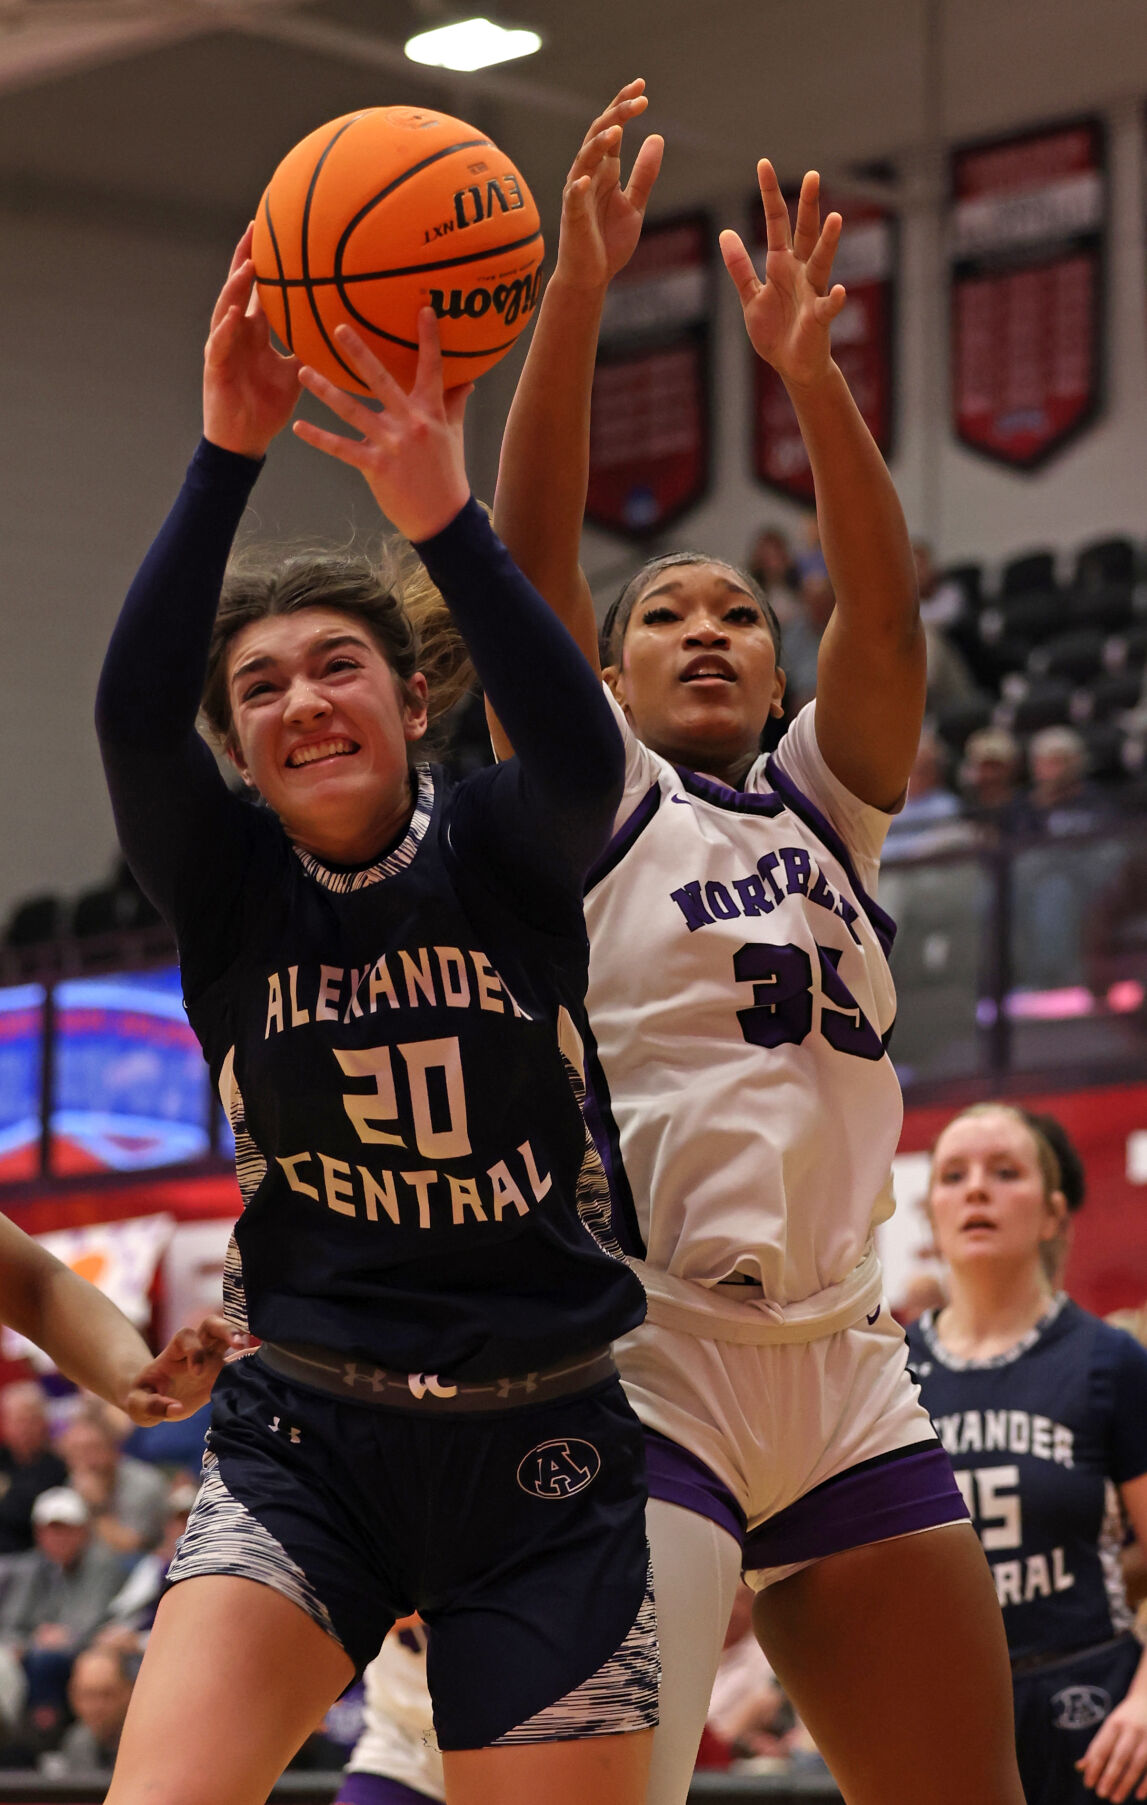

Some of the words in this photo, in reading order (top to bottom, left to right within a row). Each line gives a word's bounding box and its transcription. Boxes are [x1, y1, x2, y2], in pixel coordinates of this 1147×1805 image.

[423, 220, 454, 244] NXT
[733, 943, 885, 1062] 35
[332, 1036, 473, 1160] 20
[275, 1140, 553, 1229] CENTRAL
[534, 1442, 591, 1496] A
